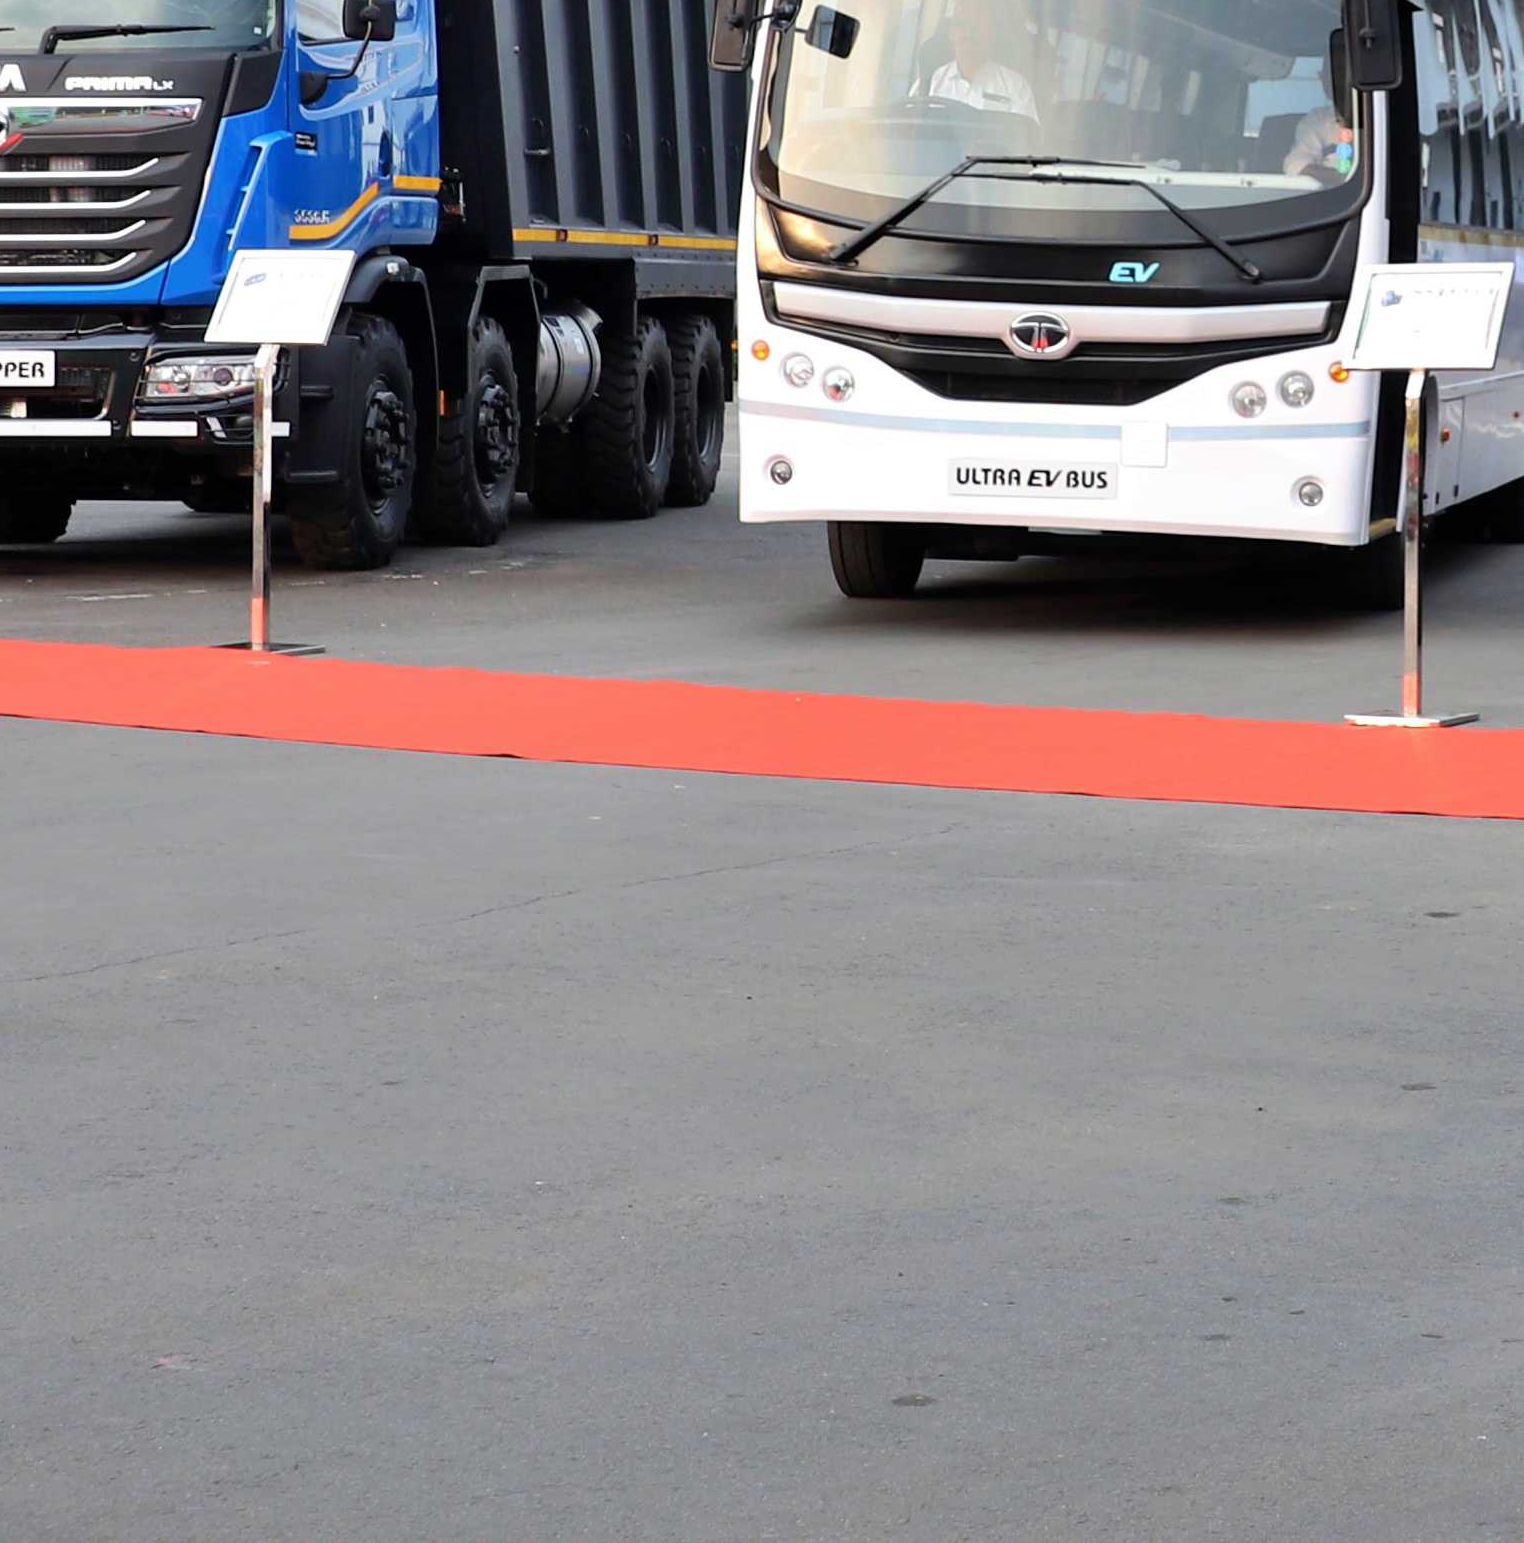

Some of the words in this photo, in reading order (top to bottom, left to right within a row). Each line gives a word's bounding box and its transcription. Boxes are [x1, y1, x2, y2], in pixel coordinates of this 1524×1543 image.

[65, 76, 153, 91] PRIMA
[1109, 262, 1160, 283] EV
[956, 467, 1021, 487] ULTRA
[1027, 469, 1063, 488] EV
[1066, 470, 1108, 489] BUS
